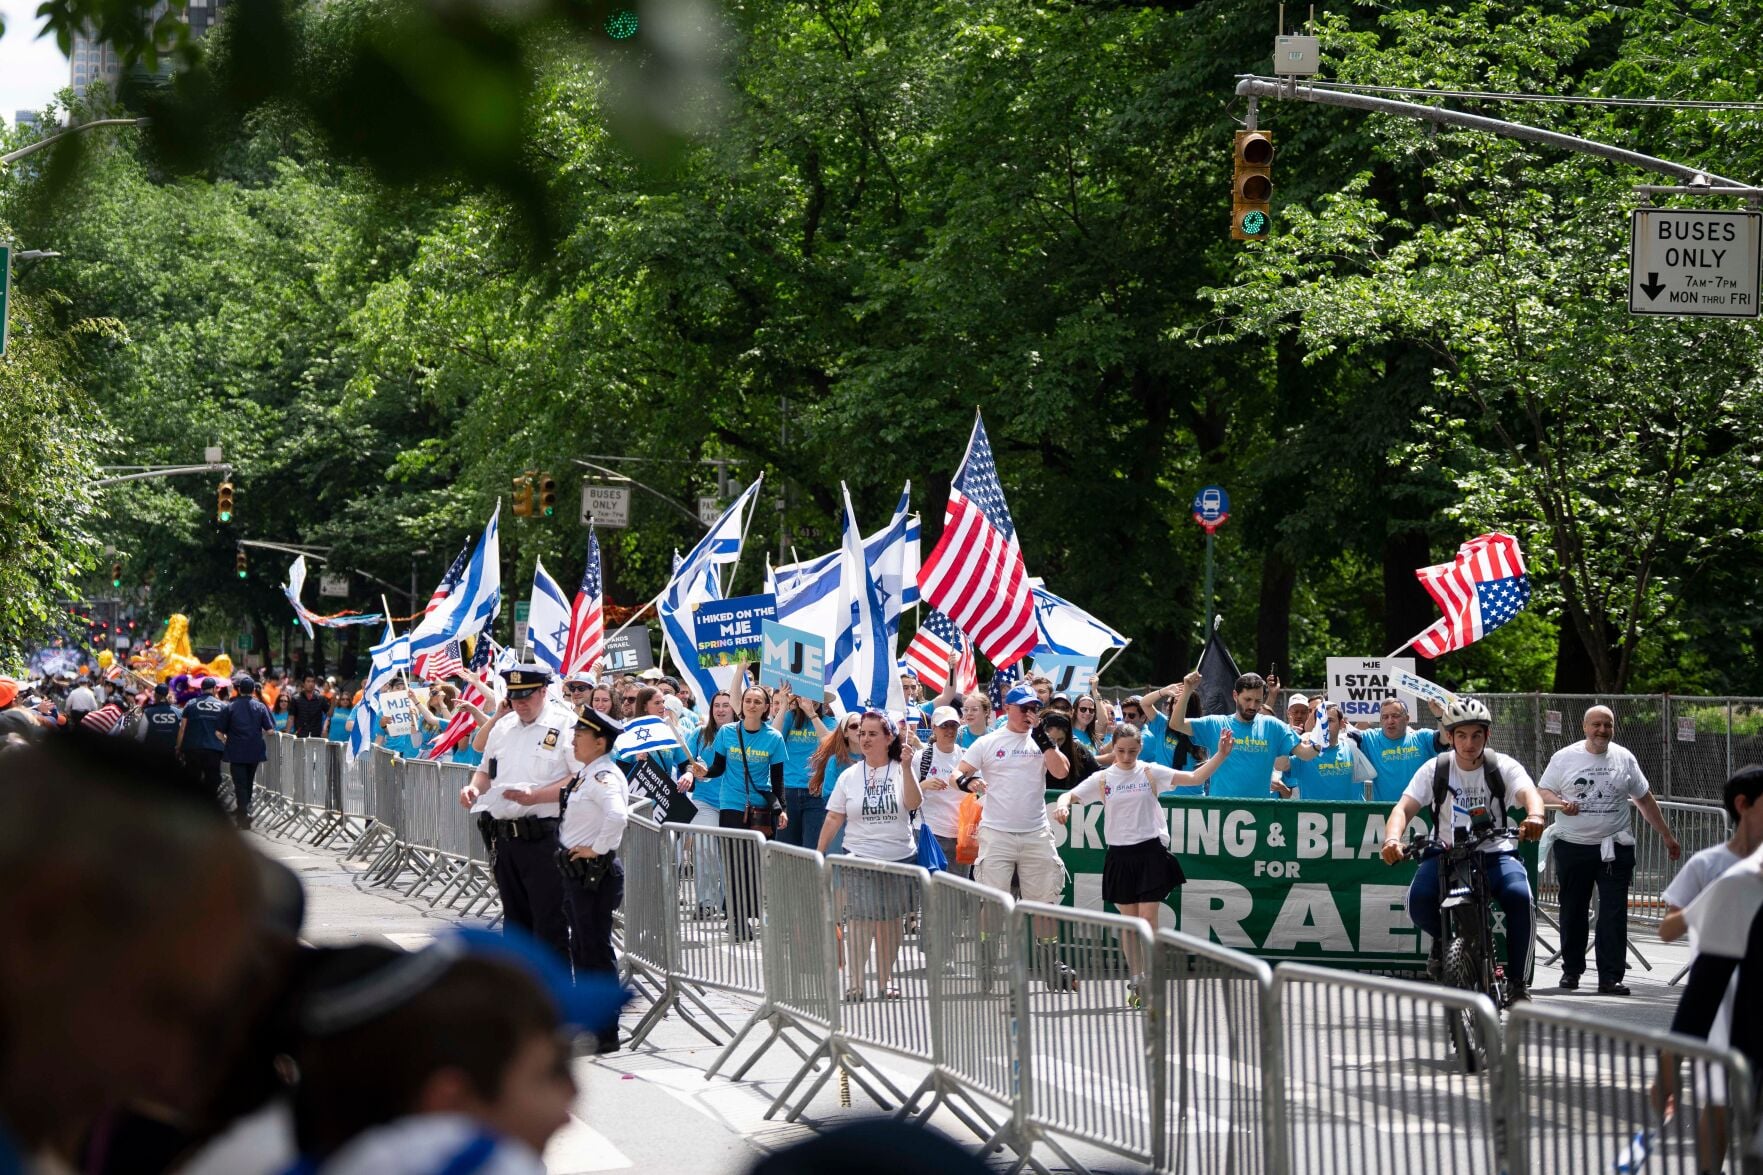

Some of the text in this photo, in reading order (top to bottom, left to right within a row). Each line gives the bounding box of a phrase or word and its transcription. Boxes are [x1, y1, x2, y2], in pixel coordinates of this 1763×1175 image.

[1659, 220, 1735, 242] BUSES
[1665, 247, 1727, 268] ONLY
[1669, 291, 1751, 305] MON THRU FRI
[590, 489, 621, 499] BUSES
[592, 500, 617, 509] ONLY
[697, 606, 775, 624] I HIKED ON THE
[720, 620, 751, 637] MJE
[607, 641, 630, 649] ISRAEL
[698, 634, 762, 650] SPRING RETR
[763, 631, 823, 681] MJE
[1362, 661, 1381, 669] MJE
[1033, 662, 1095, 693] MJE
[1335, 674, 1390, 687] I STAN
[1348, 688, 1397, 701] WITH
[197, 701, 222, 712] CSS
[387, 697, 411, 709] MJE
[1341, 701, 1381, 714] ISRA
[152, 713, 176, 724] CSS
[391, 712, 412, 724] ISR
[642, 761, 671, 796] I went to
[636, 769, 670, 810] Israel with
[628, 777, 668, 825] ME
[1045, 801, 1257, 858] SKING
[1266, 822, 1287, 848] &
[1253, 860, 1301, 879] FOR
